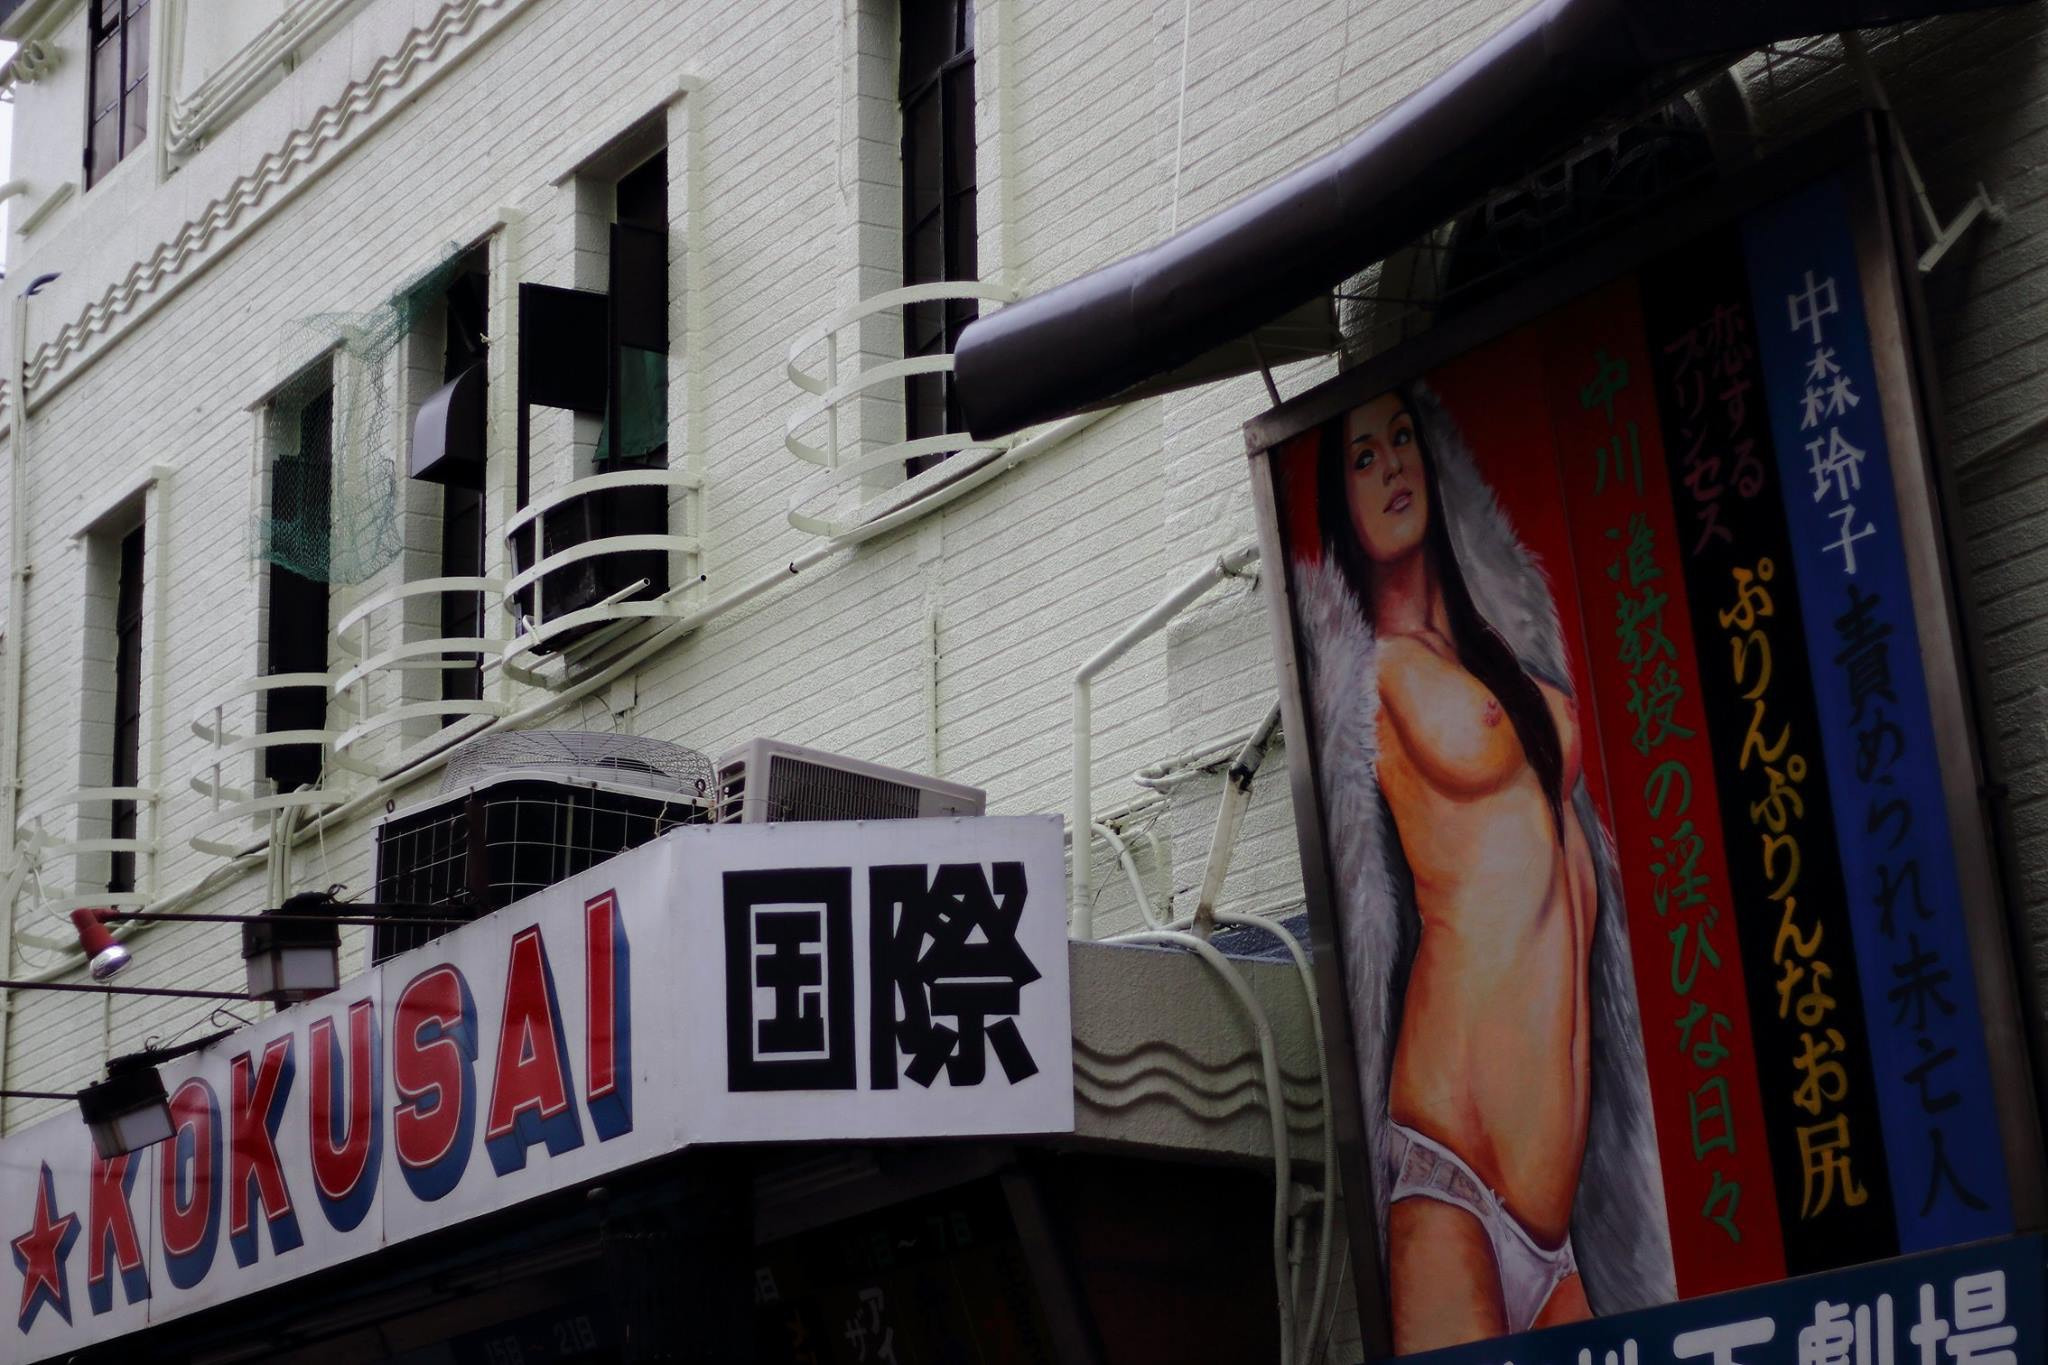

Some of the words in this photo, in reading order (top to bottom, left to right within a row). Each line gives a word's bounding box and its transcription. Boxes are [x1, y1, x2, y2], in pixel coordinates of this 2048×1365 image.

[1699, 299, 1766, 500] 恋する
[1716, 552, 1870, 1223] ぷりんぷりんなお尻
[1786, 269, 1877, 576] 中森玲子
[1833, 583, 1991, 1218] 責められ未亡人
[88, 888, 633, 1316] KOKUSAI
[723, 861, 1042, 1092] 国際
